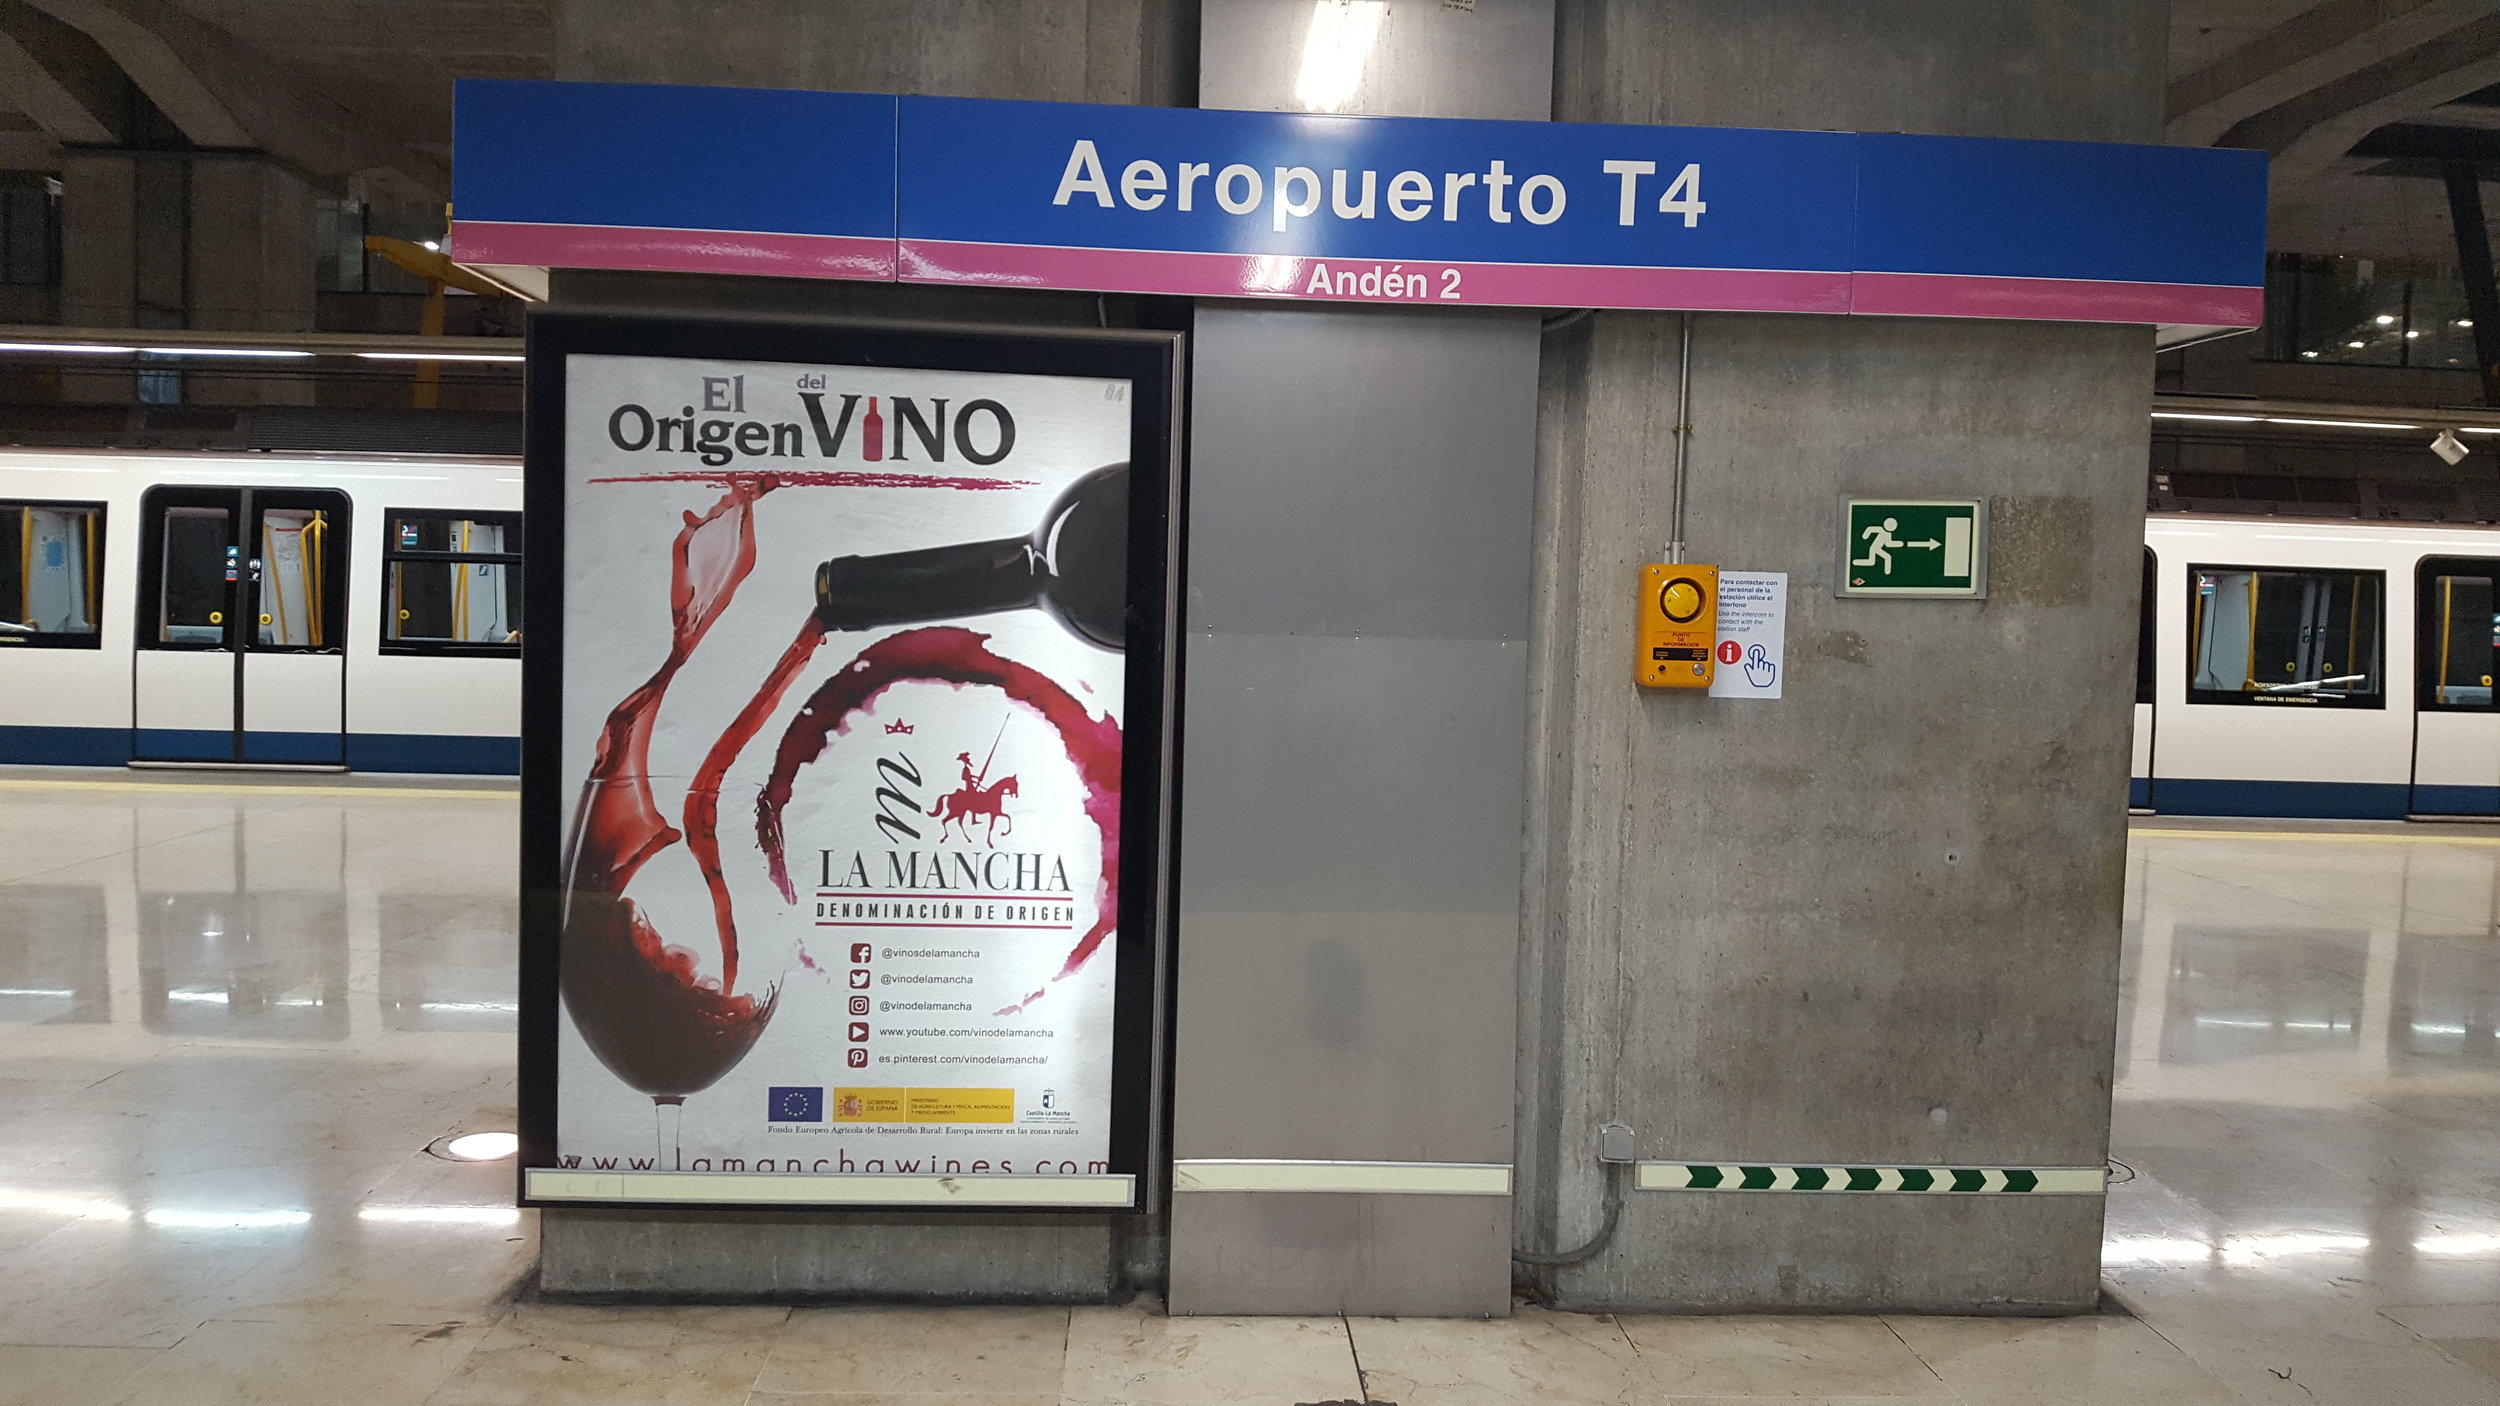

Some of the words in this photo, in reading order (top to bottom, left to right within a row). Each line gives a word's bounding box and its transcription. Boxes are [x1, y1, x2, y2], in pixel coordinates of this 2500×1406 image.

[1052, 139, 1568, 232] Aeropuerto
[1602, 160, 1707, 229] T4
[1306, 264, 1428, 300] Andén
[1440, 269, 1462, 300] 2
[796, 373, 826, 390] del
[702, 375, 746, 413] El
[608, 403, 805, 467] Origen
[817, 849, 873, 888] LA
[885, 850, 1074, 892] MANCHA
[816, 902, 963, 919] DENOMINACIÓN
[974, 905, 995, 920] DE
[1006, 905, 1074, 921] ORIGEN
[881, 948, 980, 959] @vinosdelamancha
[880, 974, 973, 985] @vinodelamancha
[879, 1001, 972, 1012] @vinodelamancha
[879, 1027, 1054, 1039] www.youtube.com/vinodelamancha
[878, 1053, 1048, 1065] es.pinterest.com/vinodelamancha/
[796, 1126, 829, 1135] Europeo
[831, 1126, 863, 1135] Agrícola
[865, 1126, 874, 1134] de
[877, 1126, 918, 1134] Desarrollo
[946, 1127, 974, 1135] Europa
[976, 1127, 1004, 1135] invierte
[1017, 1127, 1028, 1135] las
[1053, 1127, 1079, 1135] rurales
